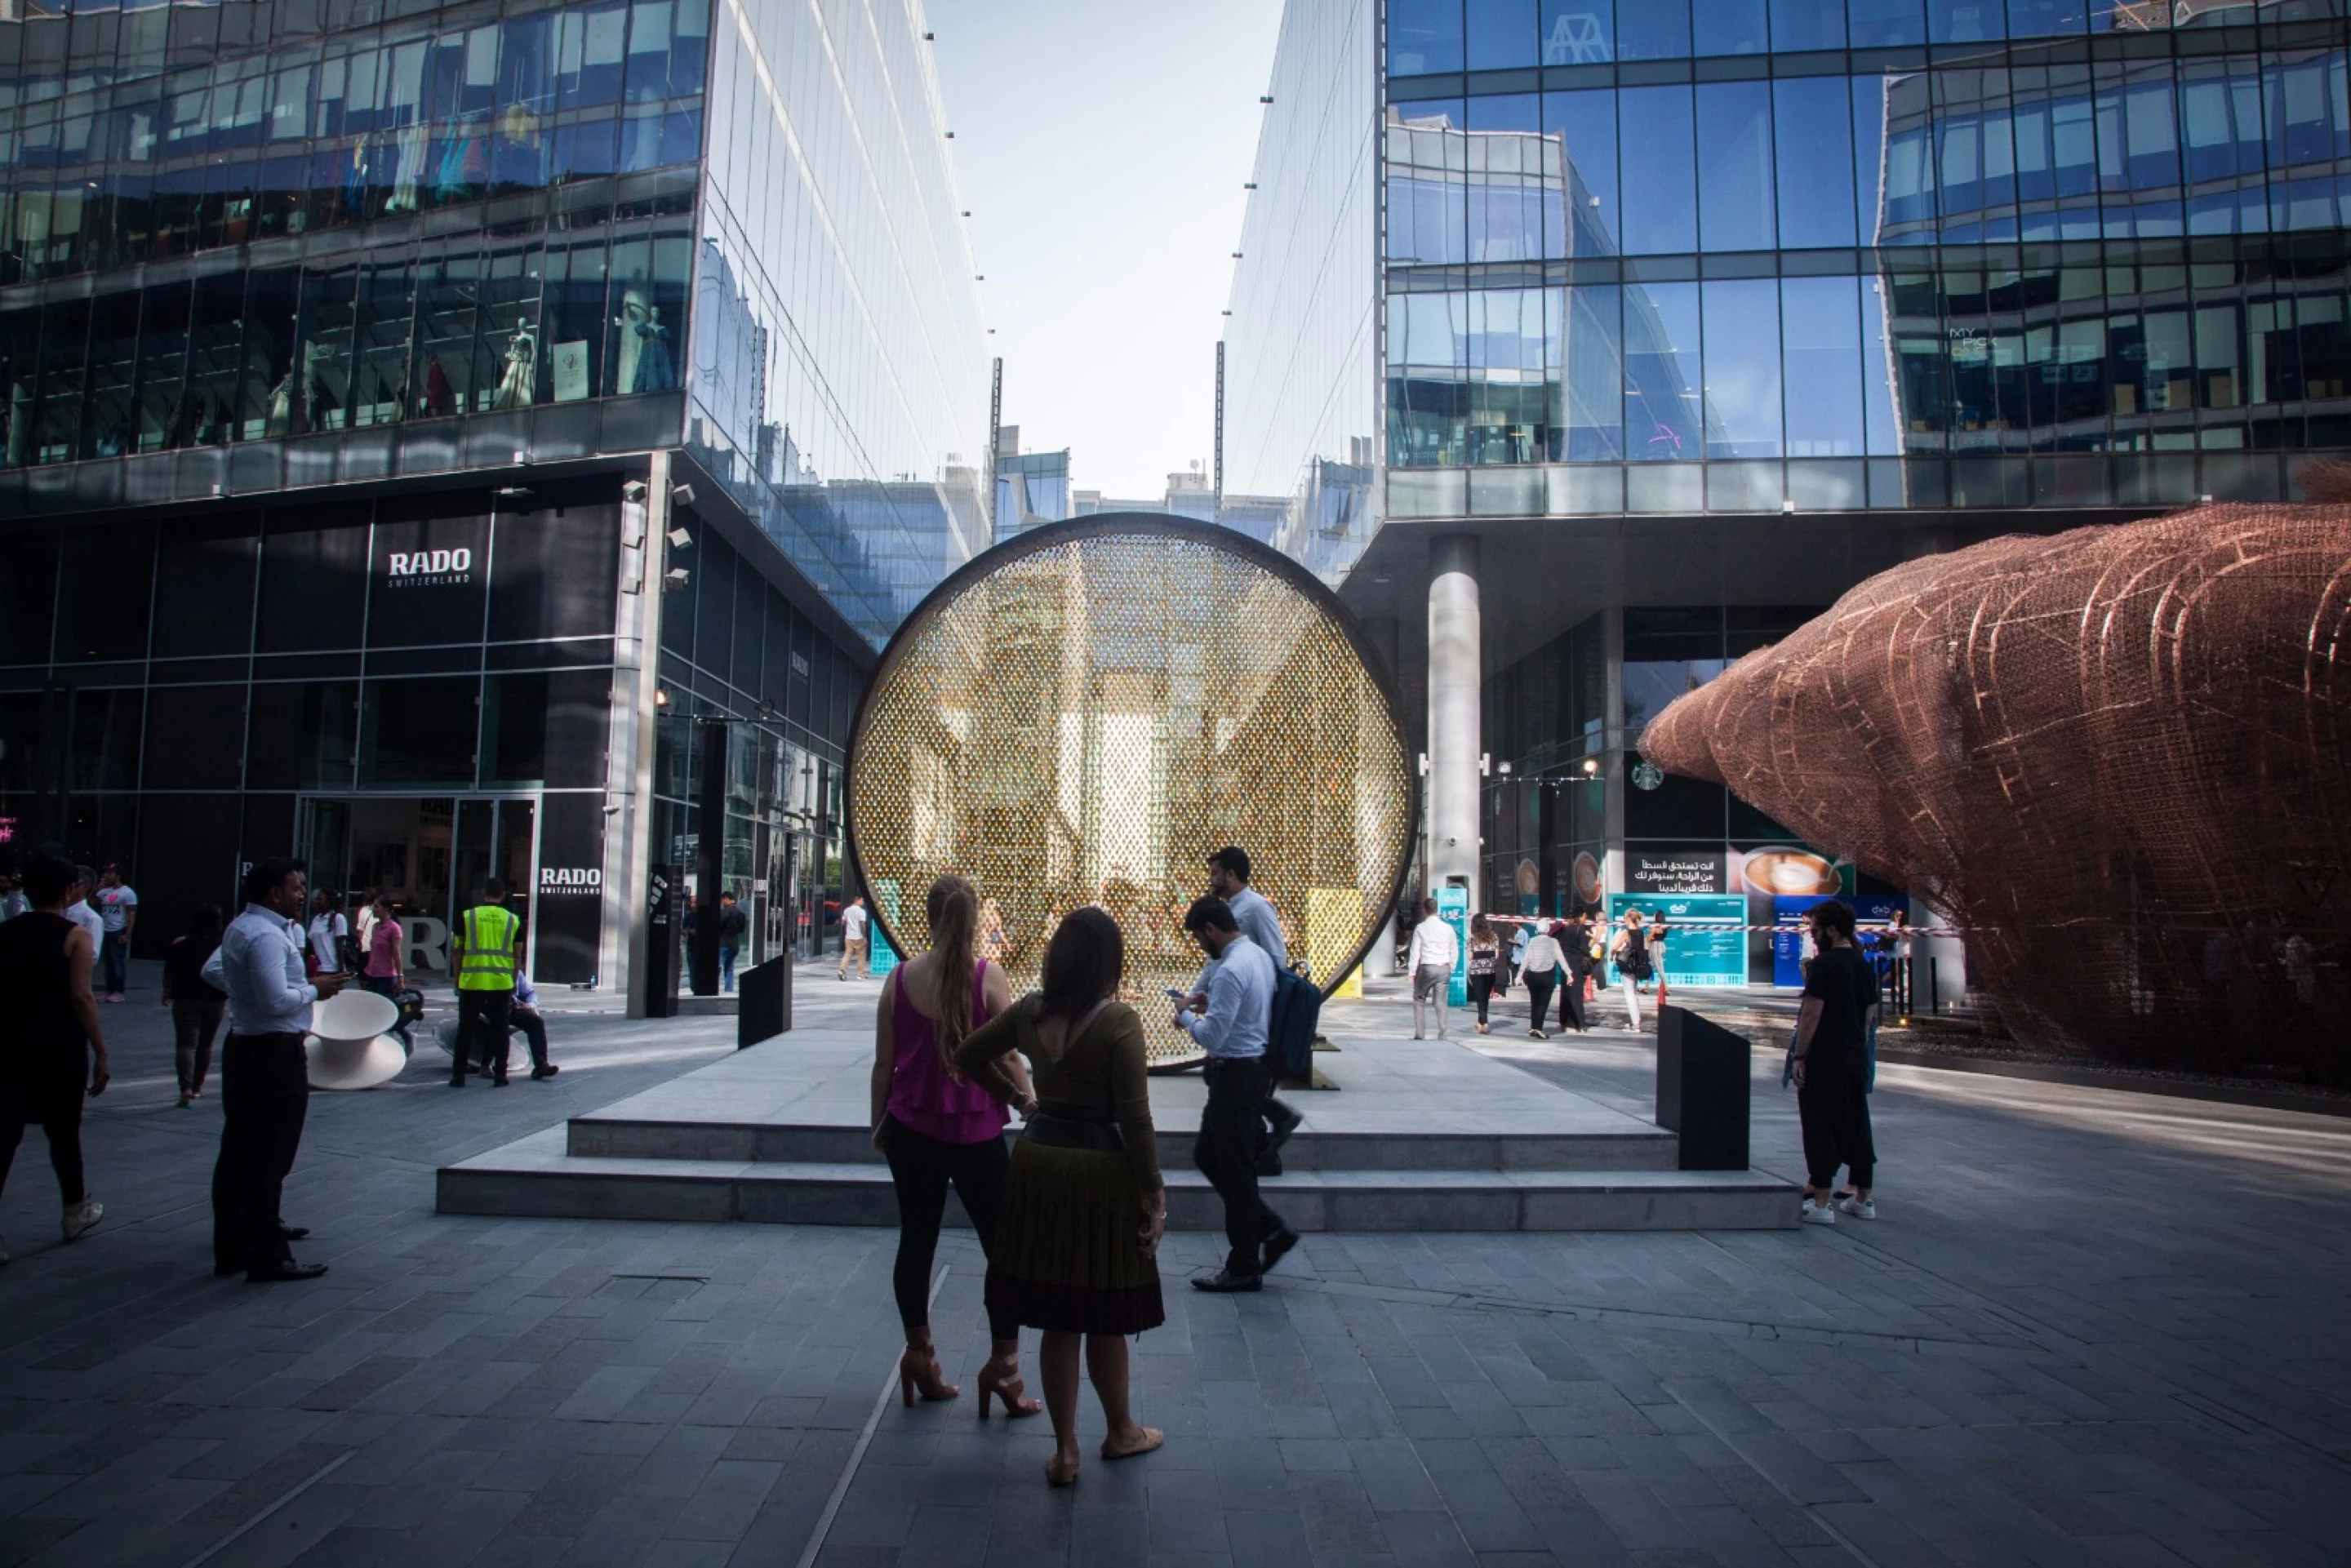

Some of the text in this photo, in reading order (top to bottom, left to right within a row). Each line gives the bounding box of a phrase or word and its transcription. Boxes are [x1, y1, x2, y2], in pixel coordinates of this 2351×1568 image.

[1950, 328, 1975, 337] MY
[389, 548, 471, 575] RADO
[388, 574, 470, 588] SWITZERLAND
[540, 868, 601, 886] RADO
[540, 887, 601, 895] SWITZERLAND
